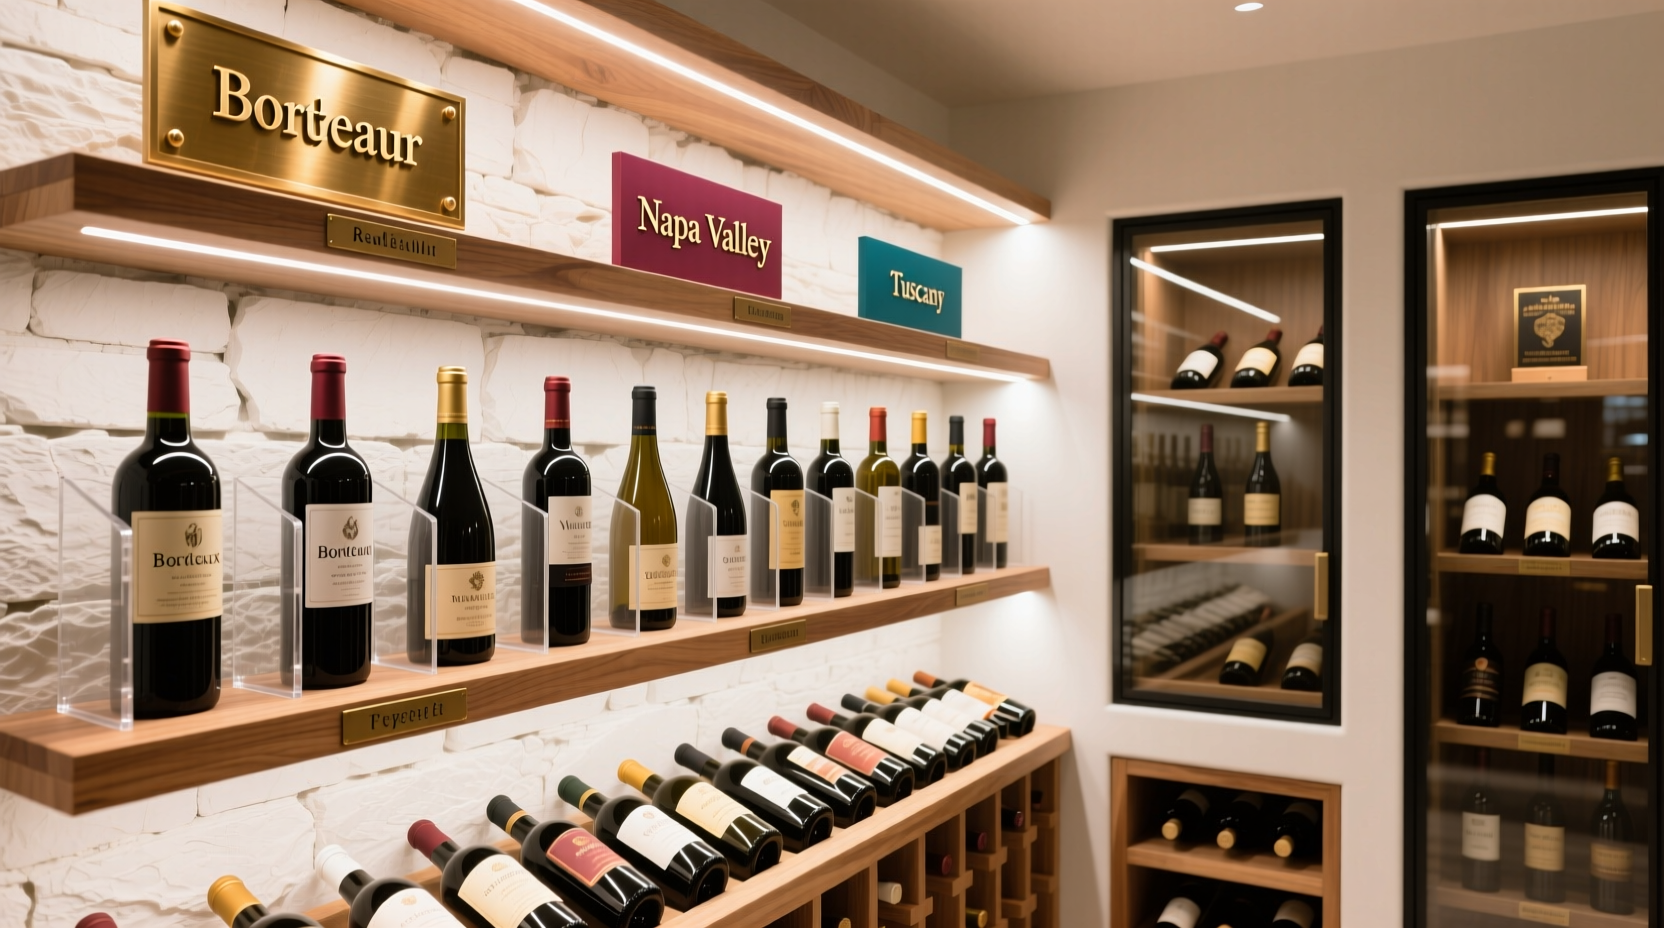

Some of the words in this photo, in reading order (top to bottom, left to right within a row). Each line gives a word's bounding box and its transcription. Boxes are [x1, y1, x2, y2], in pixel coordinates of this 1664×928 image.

[637, 195, 702, 249] Napa
[704, 213, 772, 269] Valley
[889, 269, 945, 315] Tuscany
